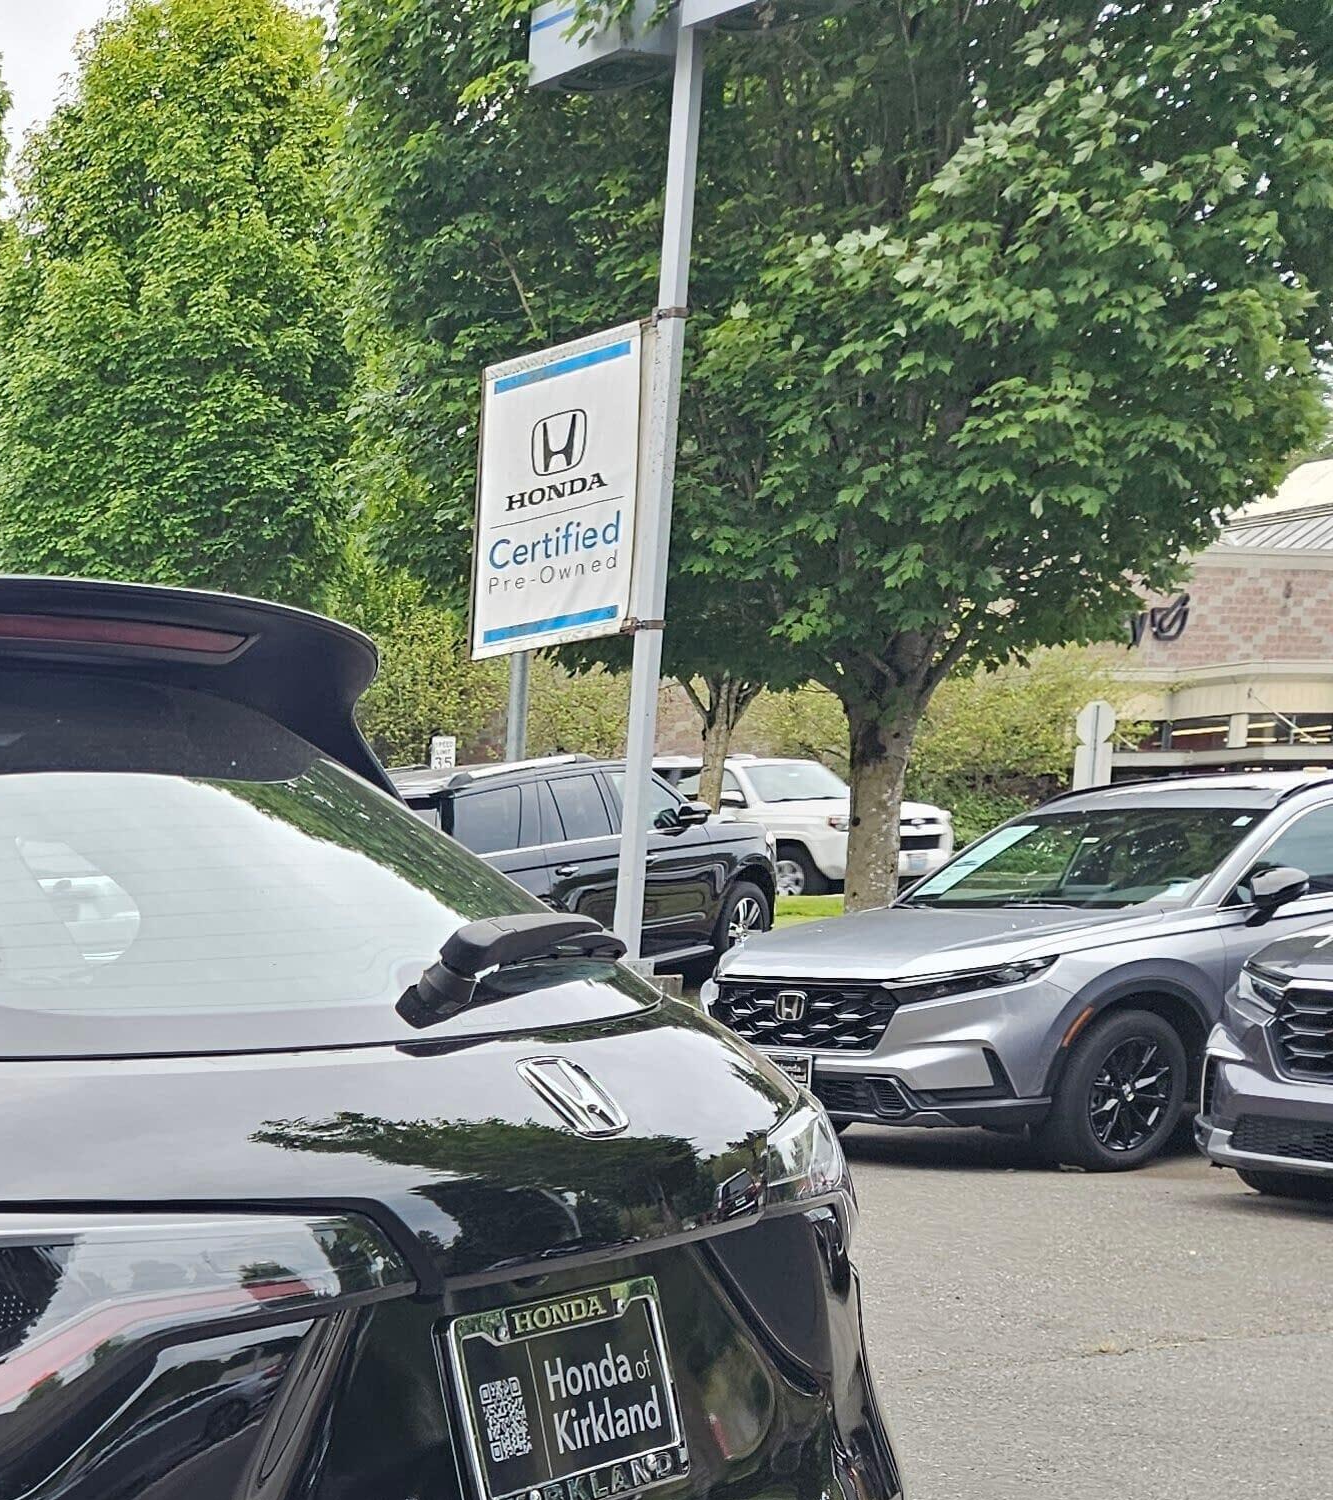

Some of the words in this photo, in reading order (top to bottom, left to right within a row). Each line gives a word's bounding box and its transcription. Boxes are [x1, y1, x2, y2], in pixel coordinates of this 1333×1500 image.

[505, 473, 608, 512] HONDA
[489, 510, 621, 570] Certified
[488, 550, 618, 594] Pre-Owned
[434, 756, 453, 768] 35
[512, 1296, 608, 1335] HONDA
[543, 1343, 633, 1402] Honda
[635, 1349, 653, 1380] of
[553, 1386, 662, 1455] Kirkland
